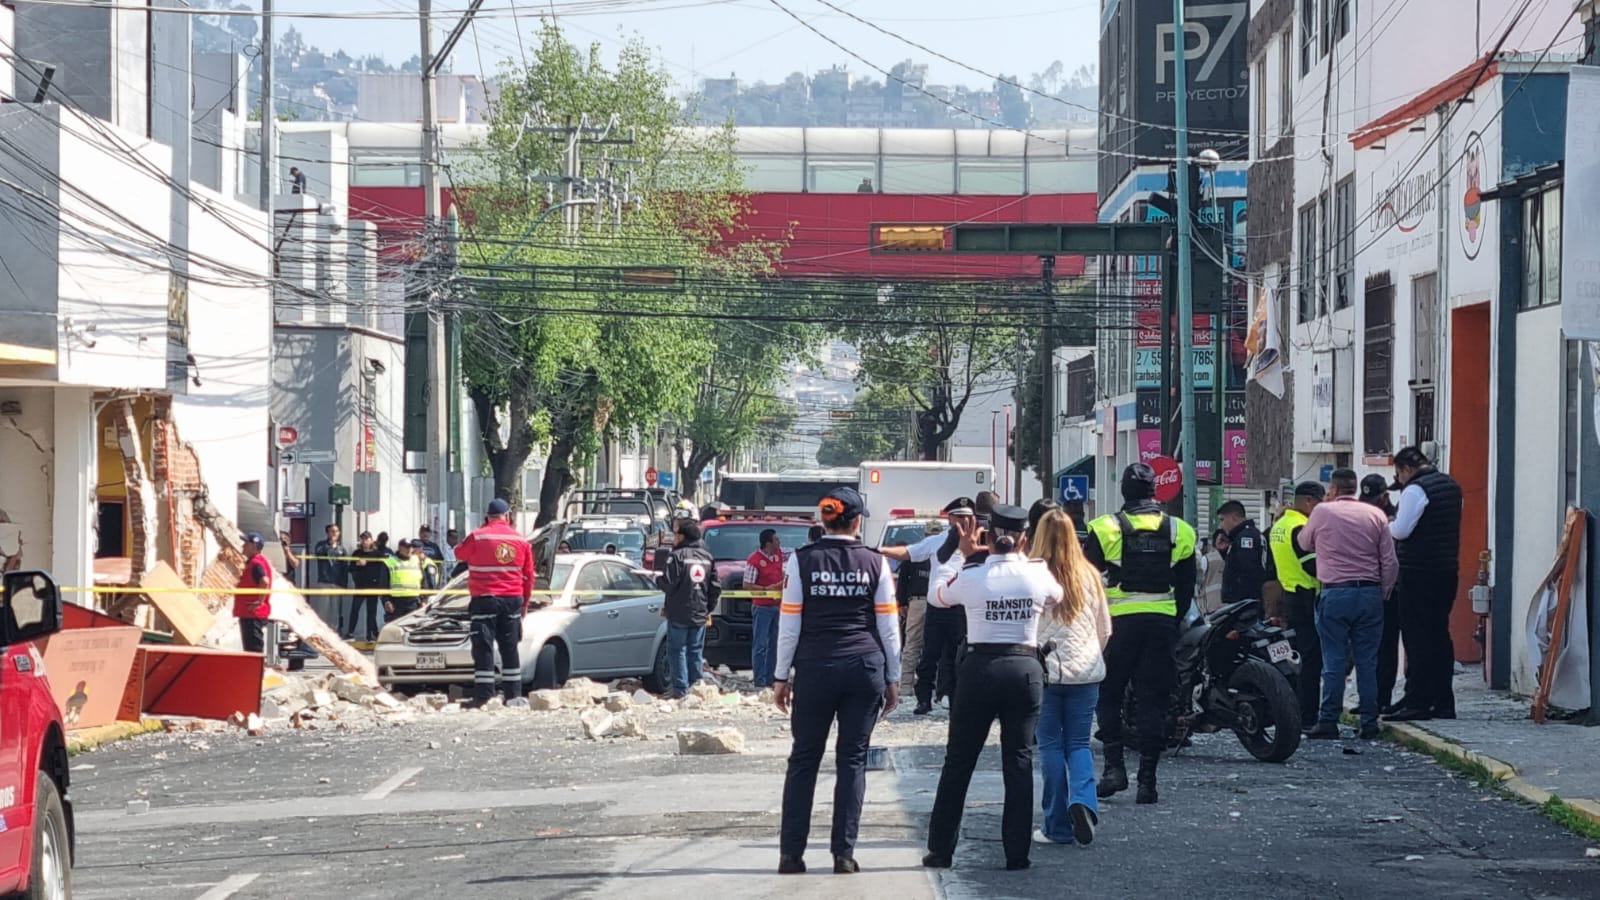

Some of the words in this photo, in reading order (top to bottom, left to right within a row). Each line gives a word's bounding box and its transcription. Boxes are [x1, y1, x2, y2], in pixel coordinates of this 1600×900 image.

[1155, 2, 1248, 84] P7
[1155, 85, 1248, 102] PRYECTO7
[1142, 414, 1161, 425] Esp
[811, 568, 870, 583] POLICÍA
[810, 585, 869, 596] ESTATAL
[985, 595, 1033, 610] TRÁNSITO
[985, 610, 1032, 621] ESTATAL
